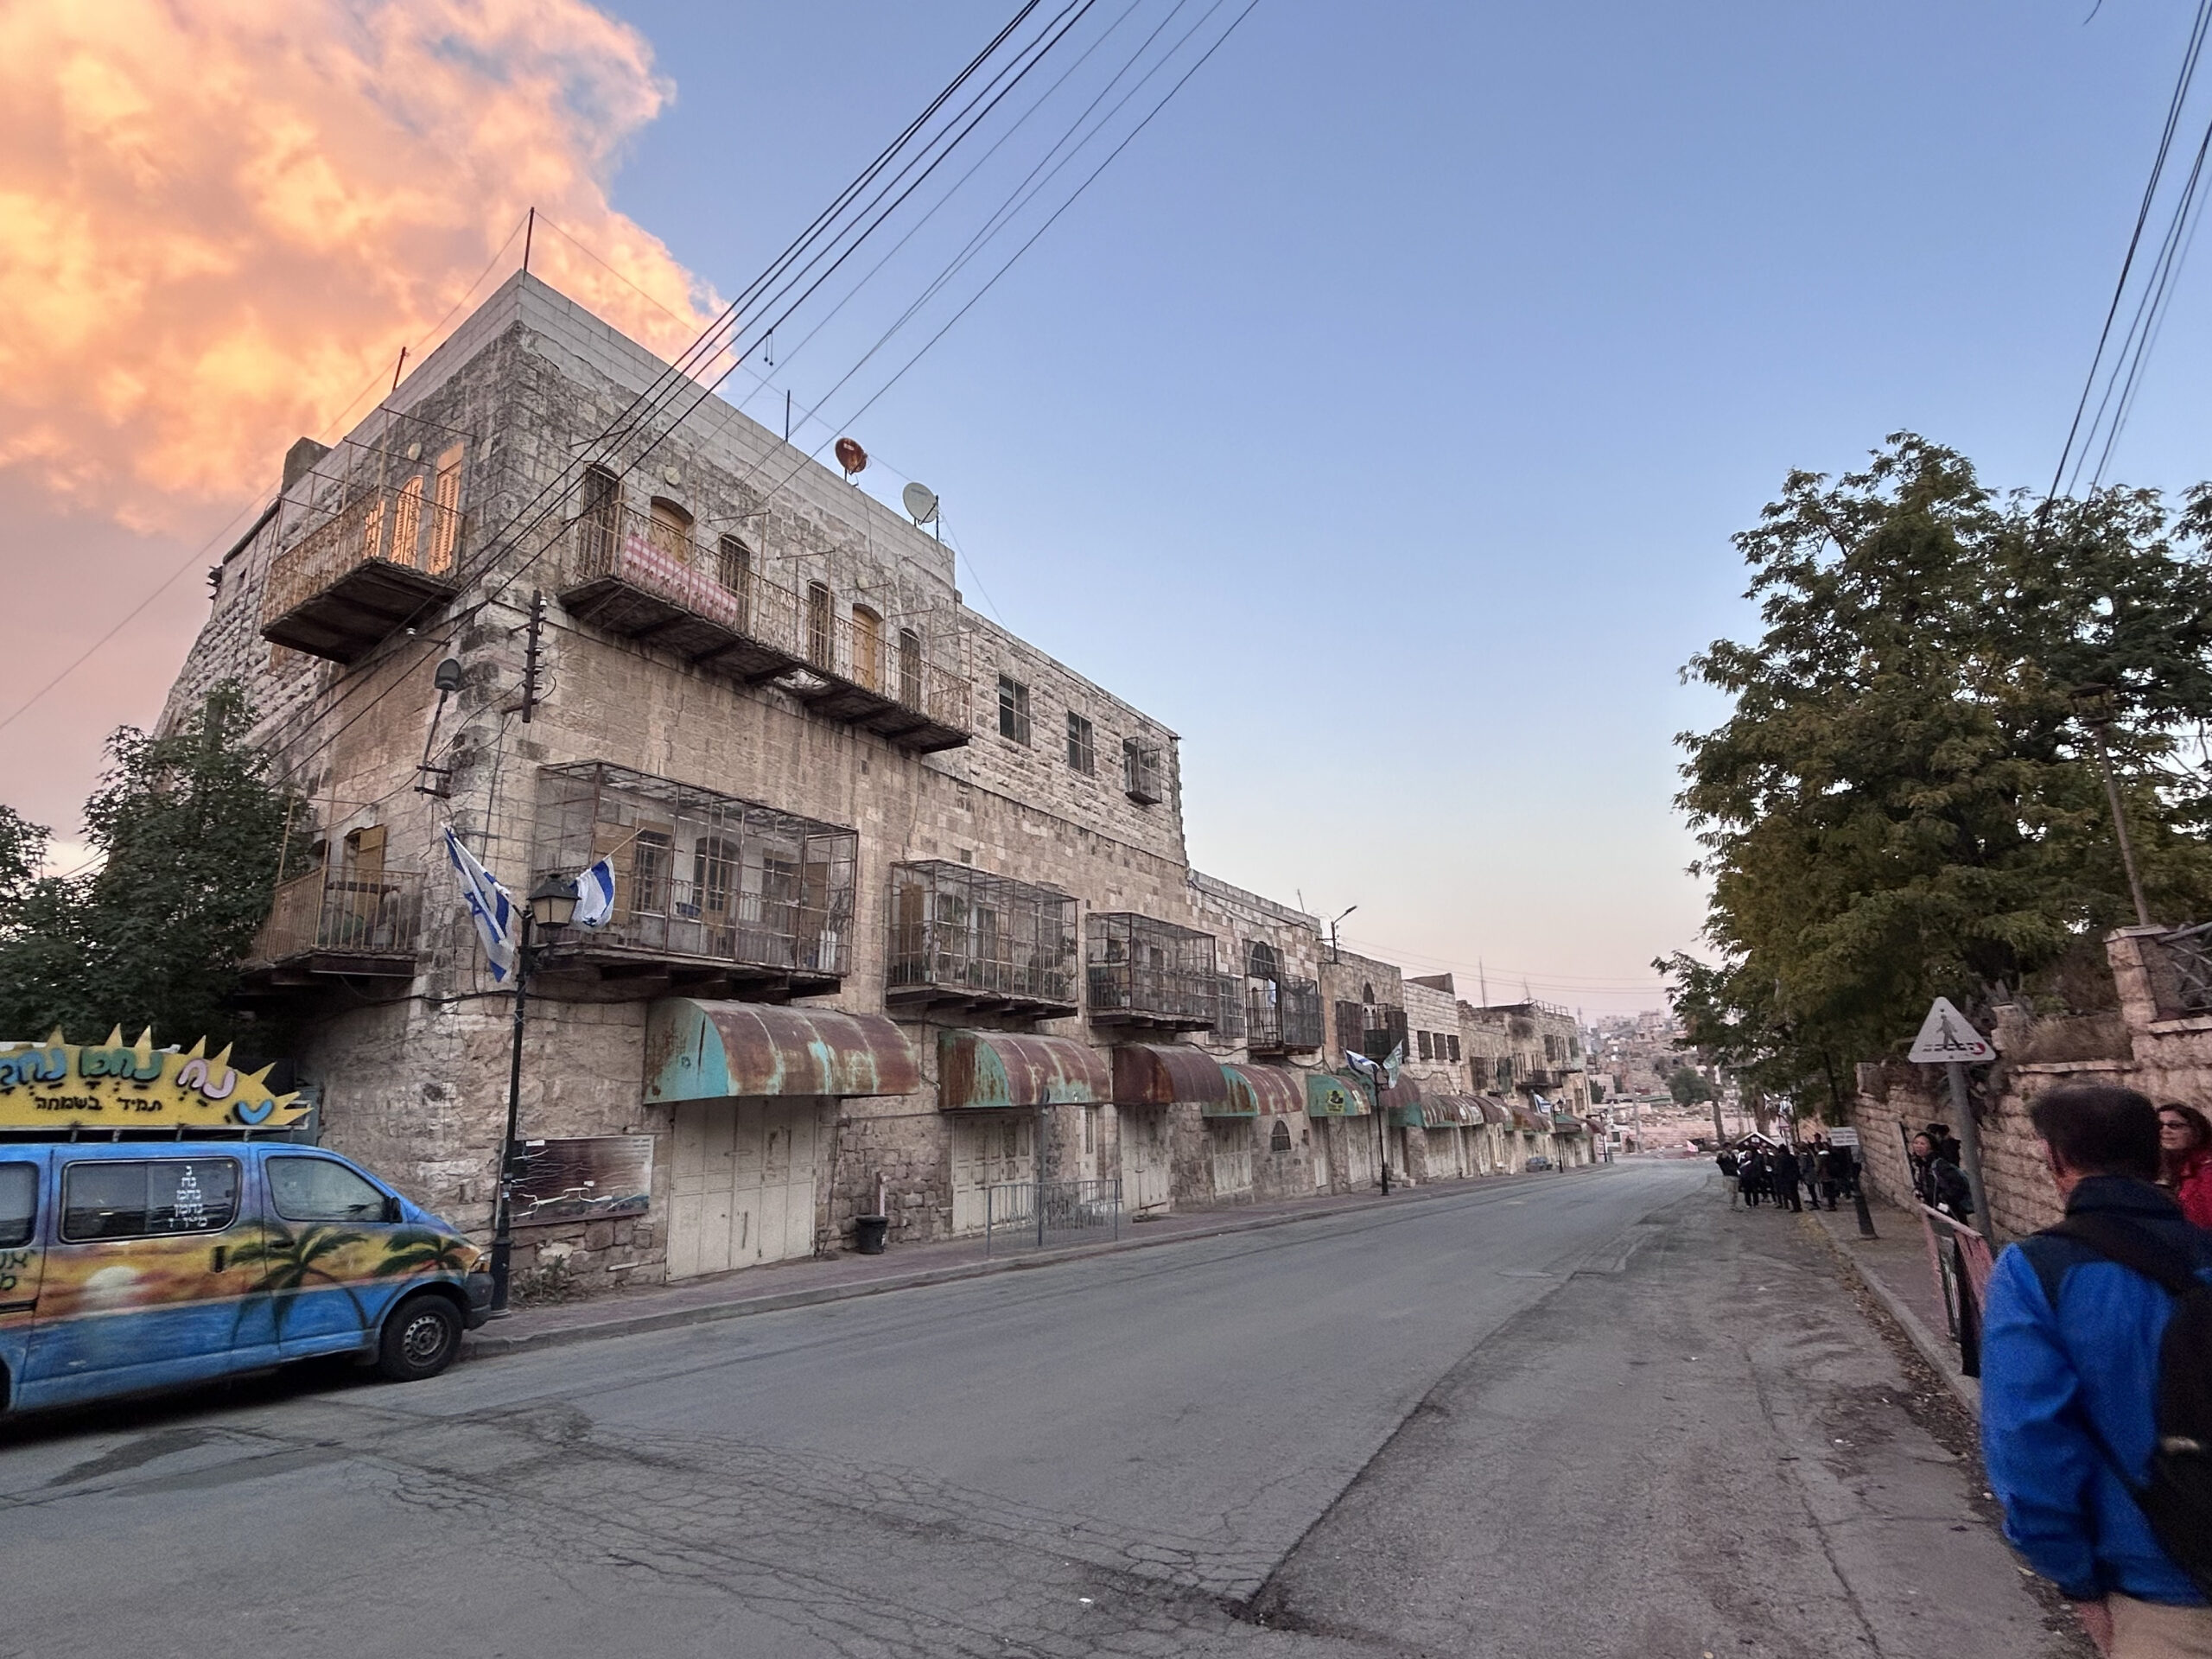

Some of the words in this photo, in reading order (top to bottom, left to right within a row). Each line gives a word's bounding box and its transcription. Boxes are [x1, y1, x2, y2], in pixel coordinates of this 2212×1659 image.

[34, 1095, 103, 1111] בשמחה
[116, 1096, 163, 1113] תמיד
[181, 1177, 197, 1187] נח
[174, 1204, 203, 1217] נחמן
